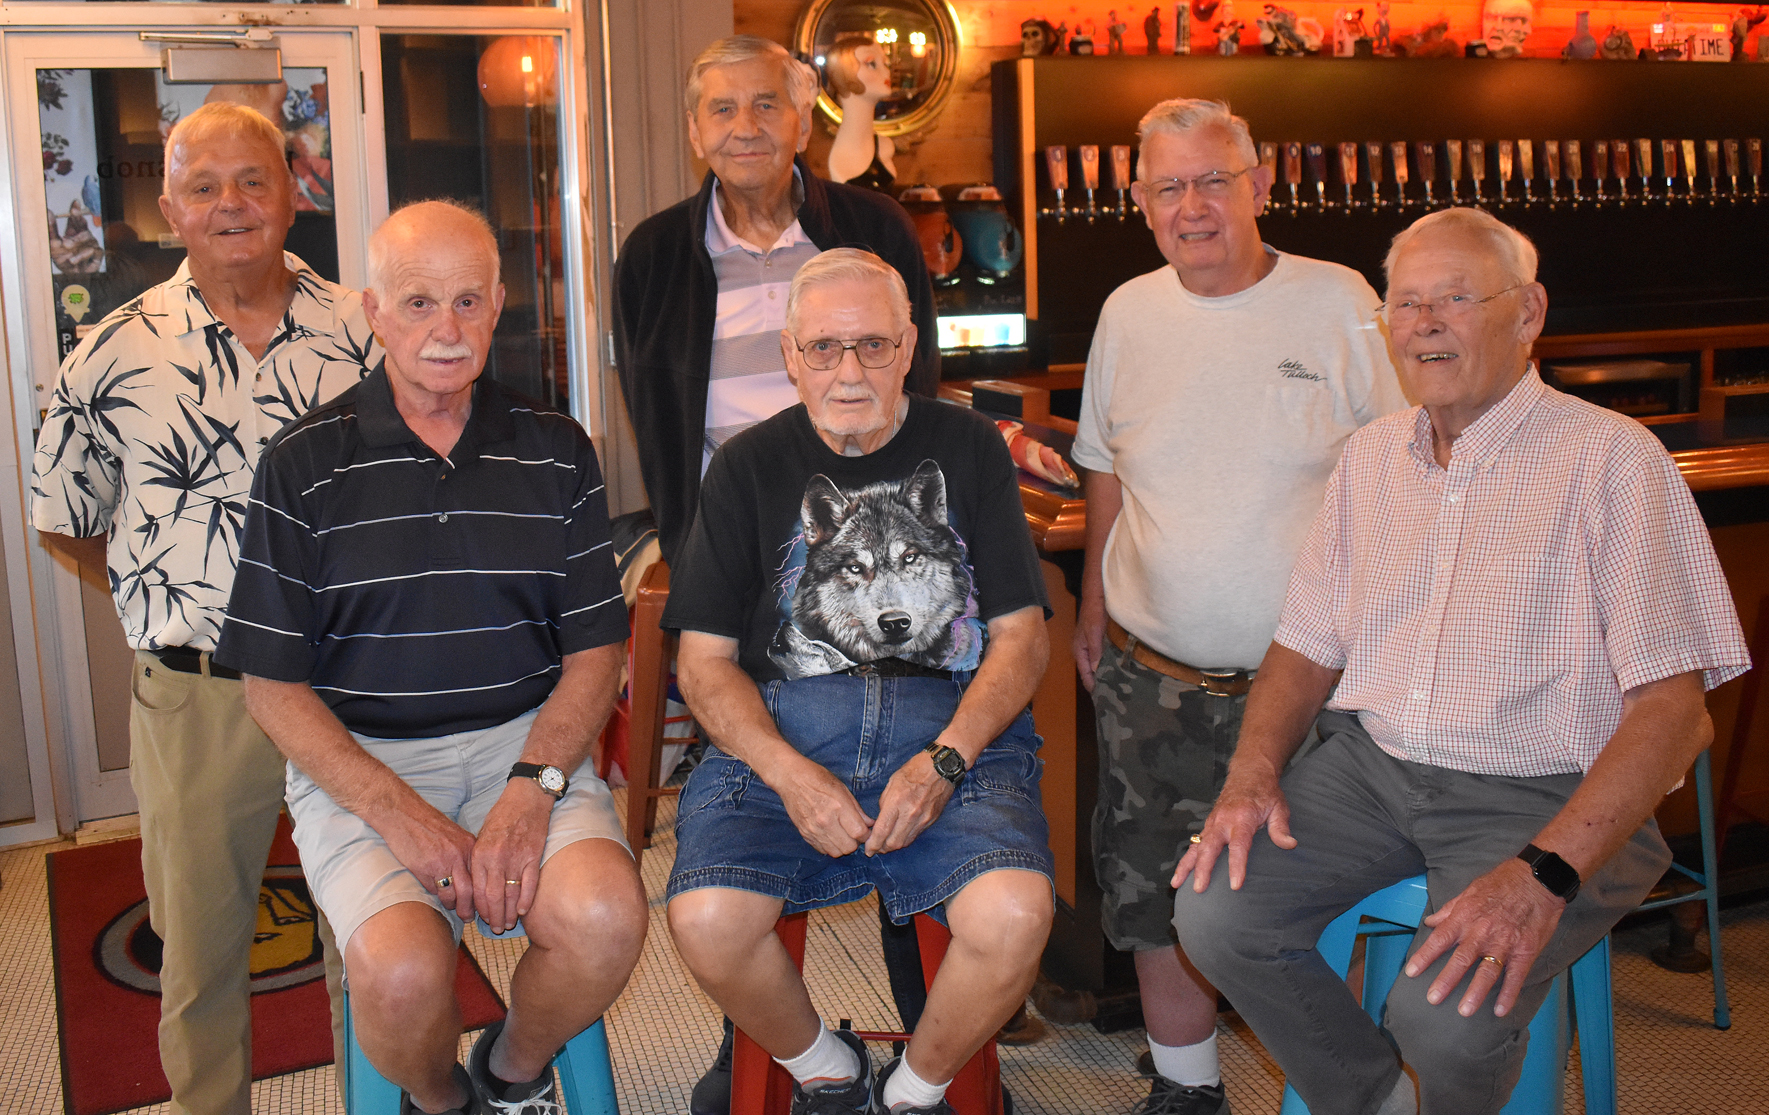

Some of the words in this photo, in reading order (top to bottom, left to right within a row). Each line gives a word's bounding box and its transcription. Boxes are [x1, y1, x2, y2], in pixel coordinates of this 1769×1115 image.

[1310, 145, 1322, 156] 10
[1344, 147, 1355, 157] 11
[1370, 145, 1380, 156] 12
[1394, 146, 1404, 156] 13
[1423, 145, 1433, 155] 14
[1472, 144, 1482, 154] 16
[1597, 144, 1606, 154] 21
[1618, 143, 1627, 153] 22
[1665, 143, 1675, 153] 24
[1278, 358, 1307, 370] Lake
